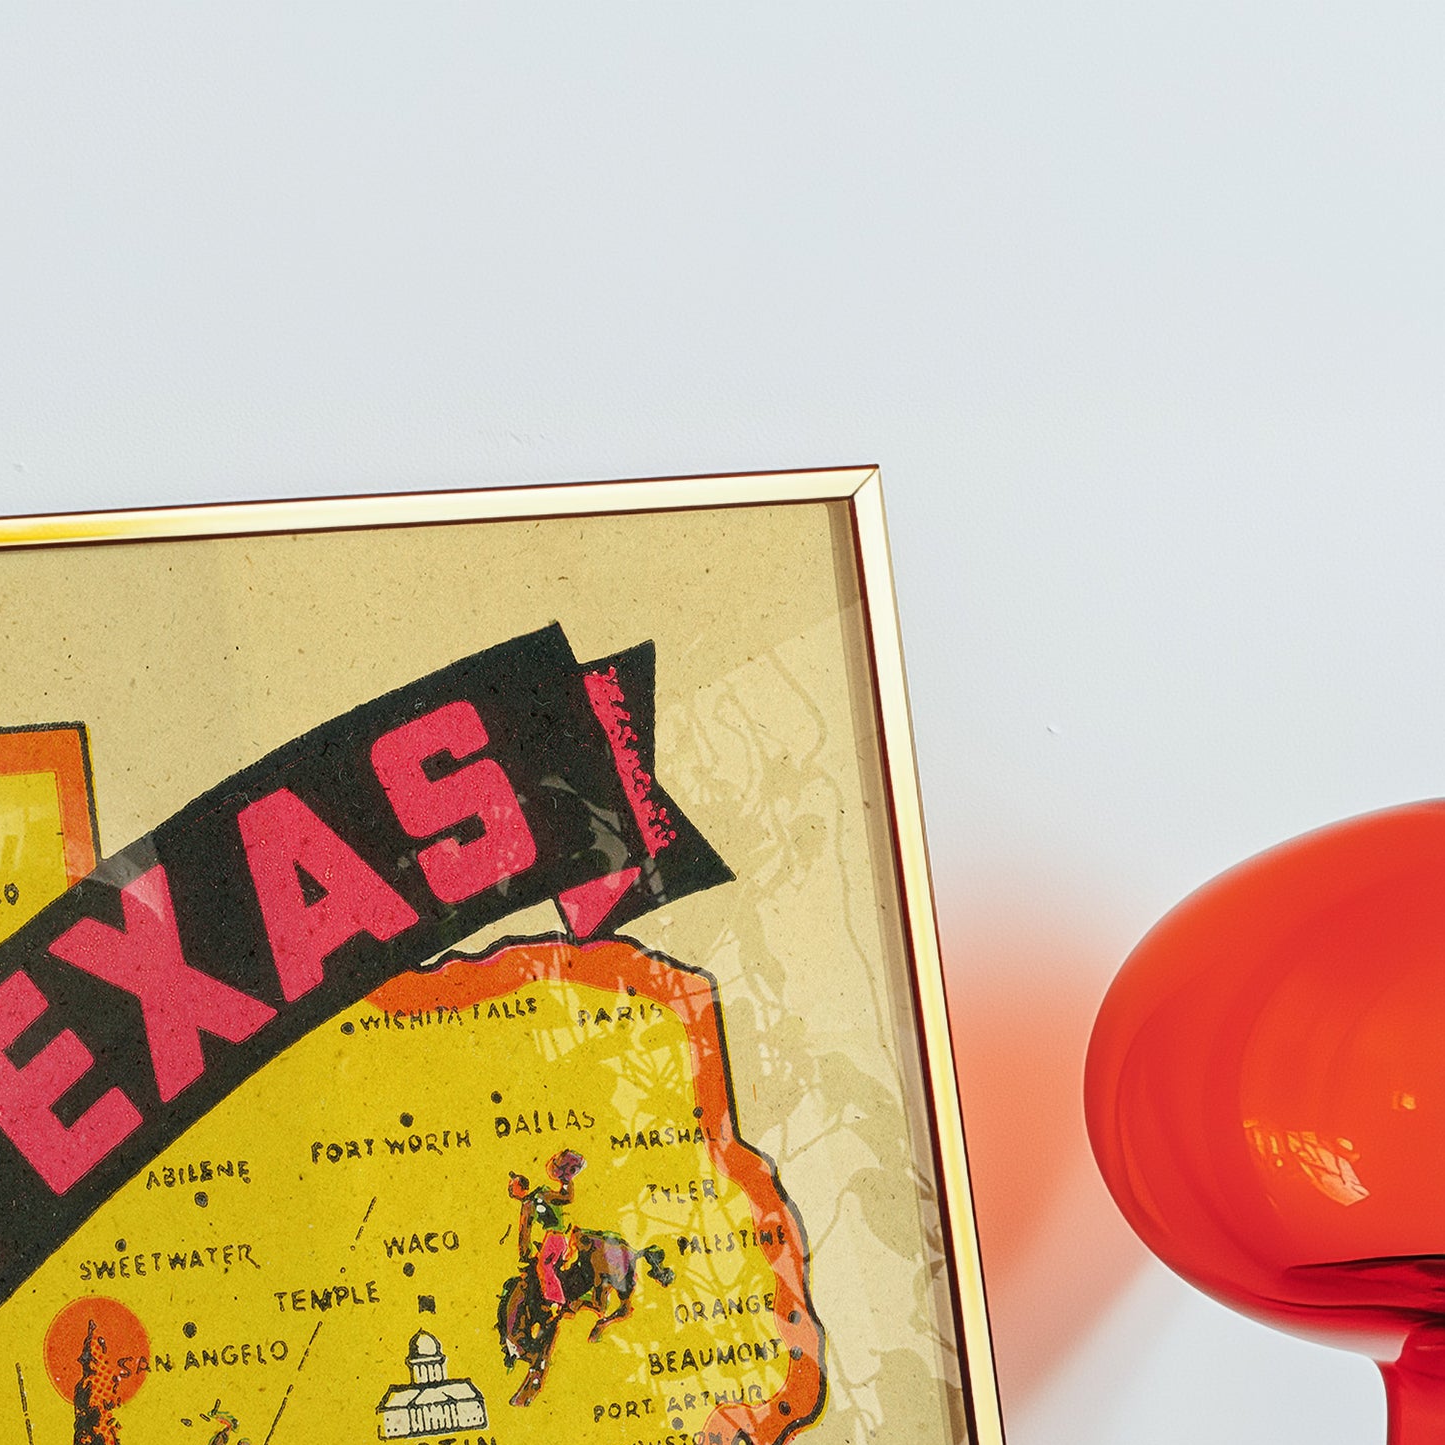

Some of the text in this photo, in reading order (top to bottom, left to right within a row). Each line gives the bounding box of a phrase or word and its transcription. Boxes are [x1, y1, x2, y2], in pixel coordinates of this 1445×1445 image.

[578, 1003, 663, 1027] PARIS
[494, 1109, 595, 1138] DALLAS
[311, 1129, 472, 1164] FORT WORTH
[146, 1160, 251, 1190] ABILENE
[647, 1179, 719, 1204] TYLER
[384, 1230, 461, 1257] WACO
[80, 1244, 260, 1280] SWEETWATER
[274, 1281, 380, 1312] TEMPLE
[675, 1293, 774, 1324] ORANGE
[116, 1340, 288, 1379] SAN ANGELO
[649, 1338, 781, 1375] BEAUMONT
[594, 1384, 766, 1423] PORT ARTHUR
